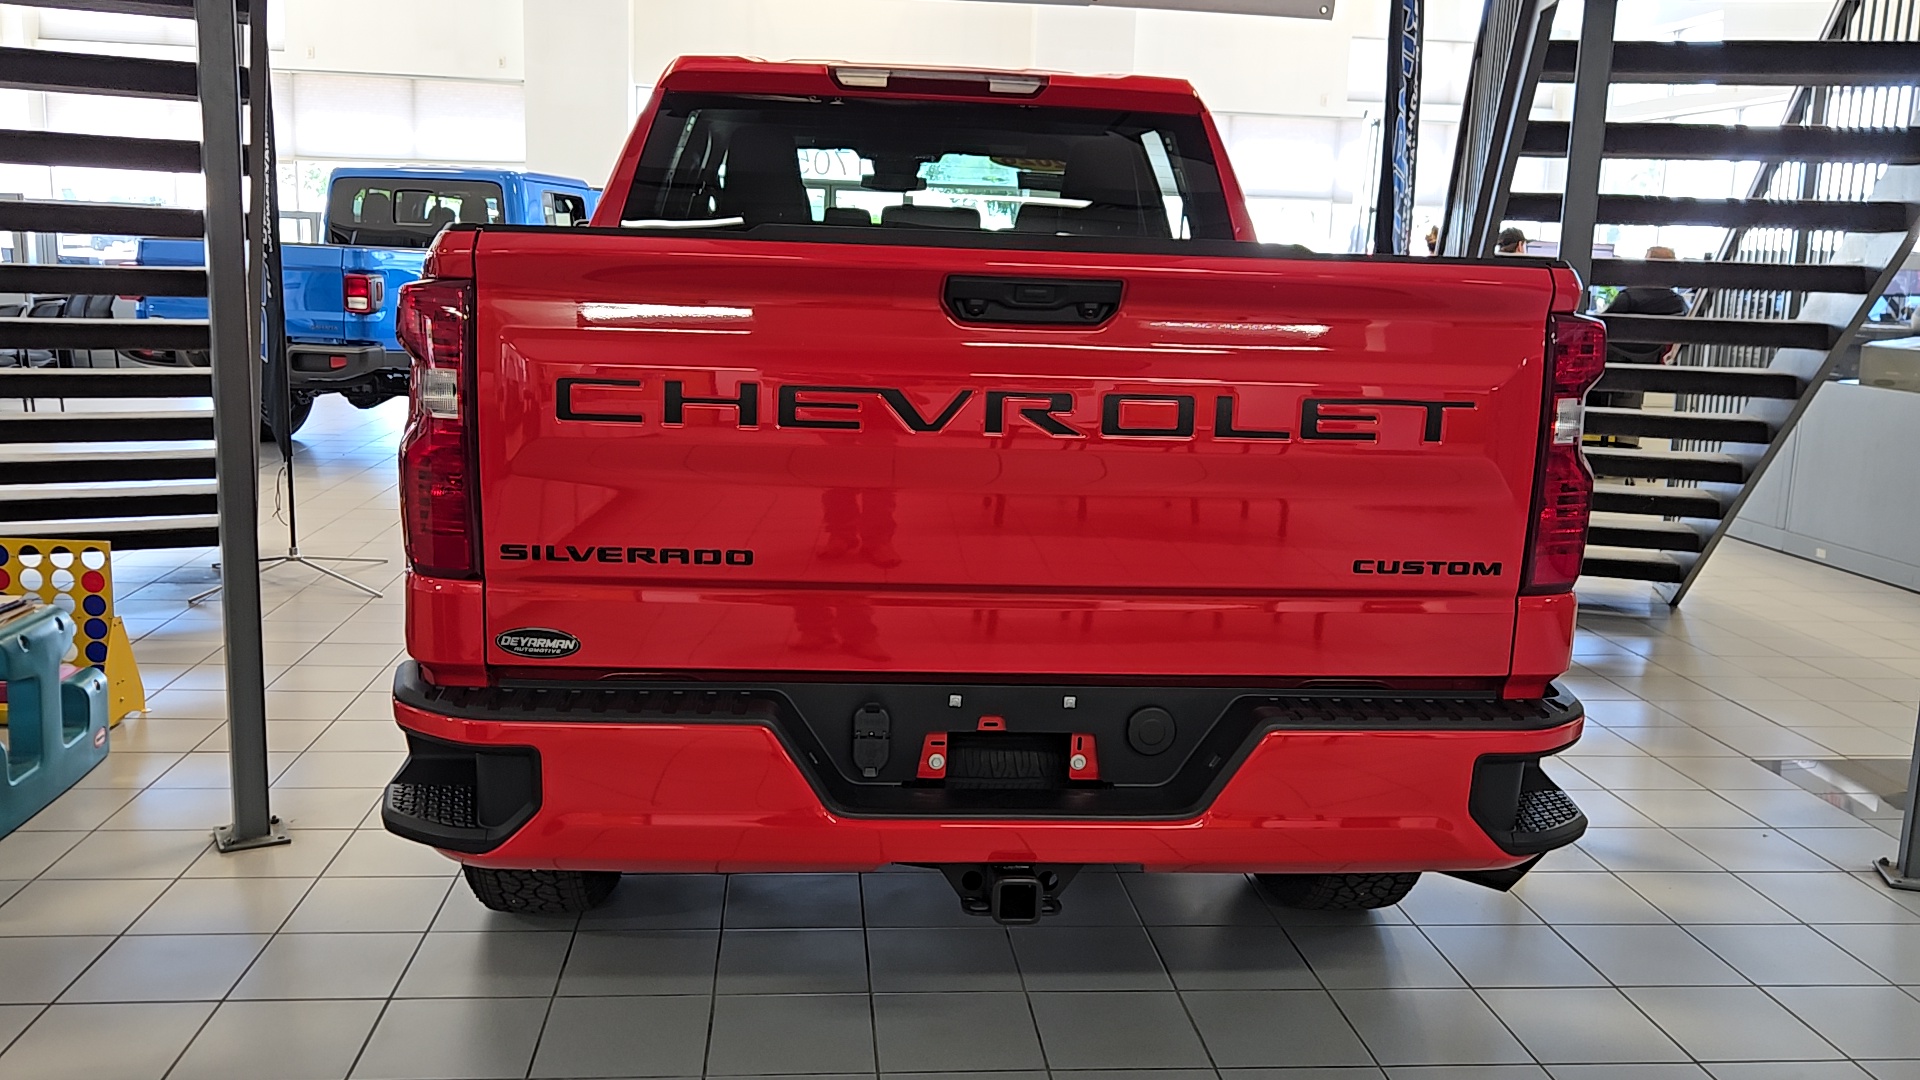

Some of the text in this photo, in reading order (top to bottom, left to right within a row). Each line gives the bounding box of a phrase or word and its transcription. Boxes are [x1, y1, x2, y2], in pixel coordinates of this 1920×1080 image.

[555, 376, 1477, 443] CHEVROLET
[500, 544, 754, 566] SILVERADO
[1353, 560, 1502, 576] CUSTOM
[501, 635, 576, 650] DEYARMAN
[514, 646, 562, 654] AUTOMOTIVE
